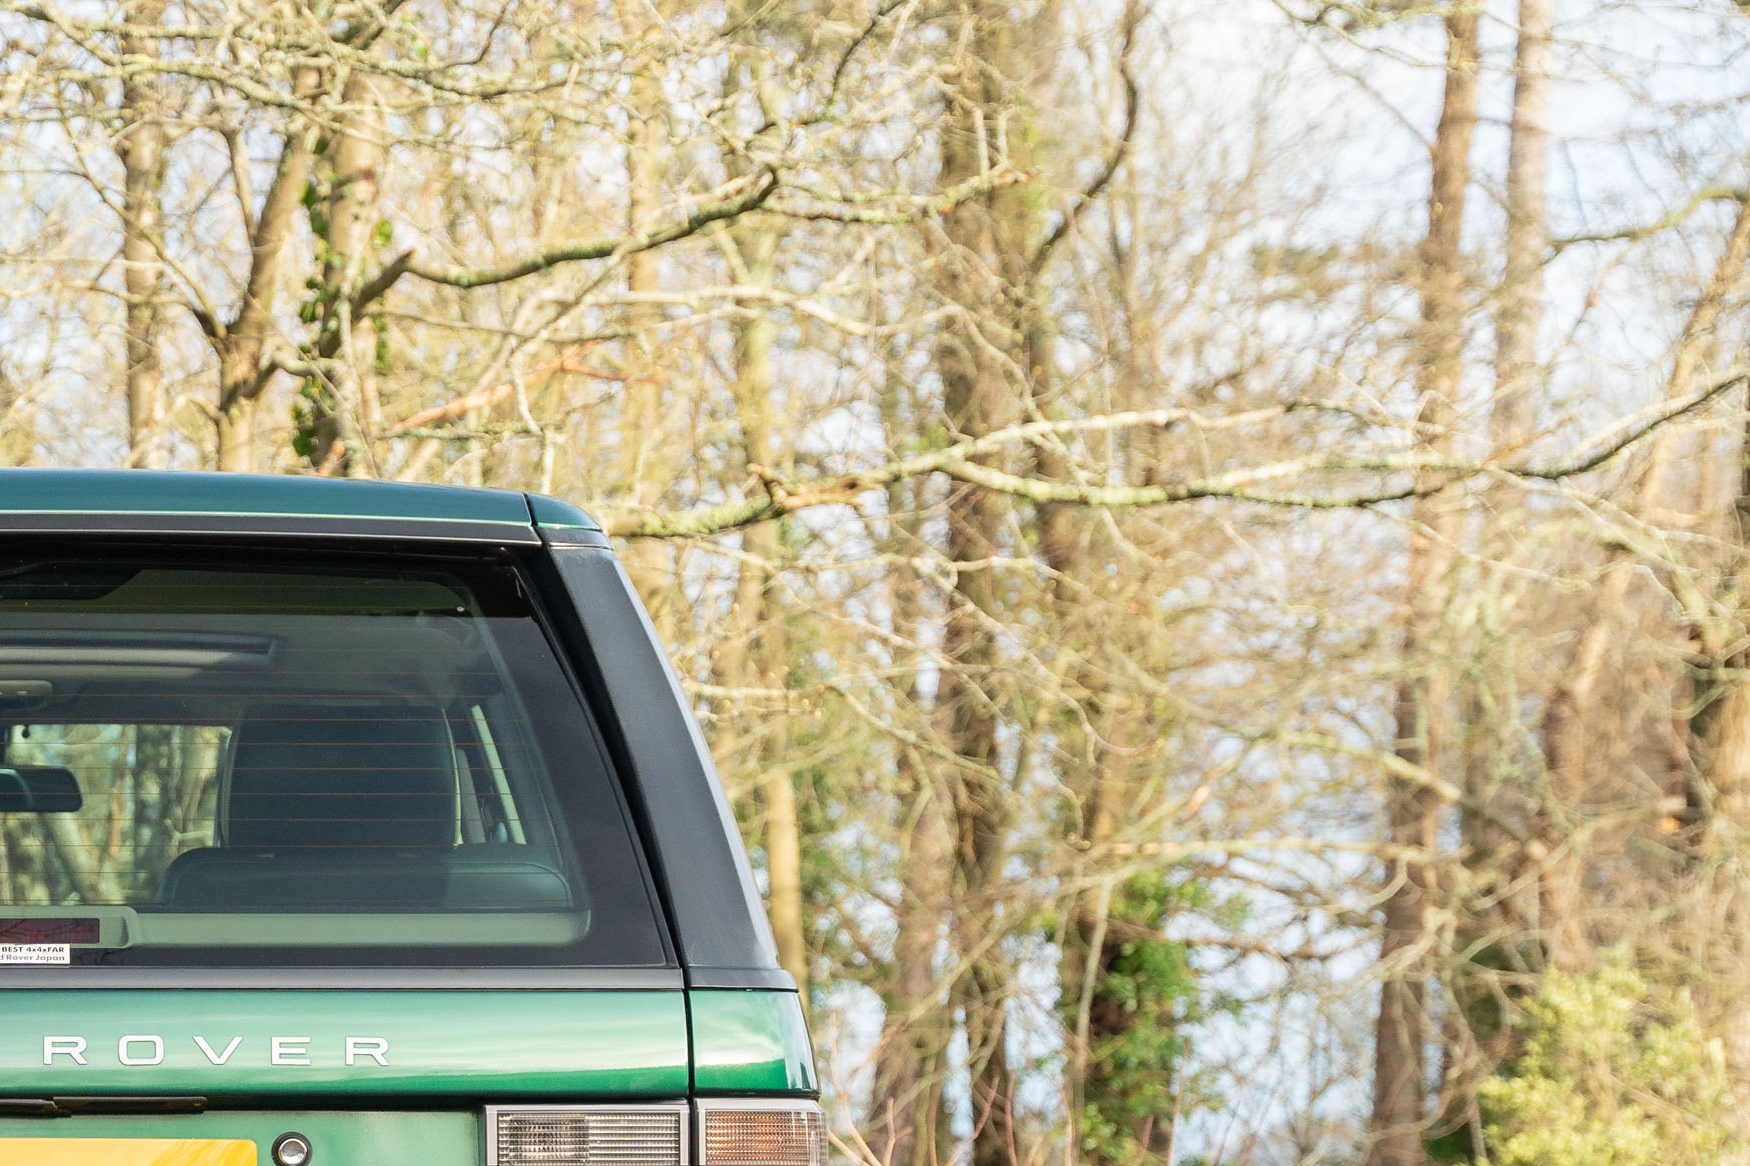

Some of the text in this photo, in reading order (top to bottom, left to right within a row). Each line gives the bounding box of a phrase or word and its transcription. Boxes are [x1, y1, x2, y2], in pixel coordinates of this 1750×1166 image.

[1, 945, 25, 953] BEST
[6, 953, 34, 962] Rover
[35, 953, 65, 963] Japan
[43, 1035, 391, 1066] ROVER
